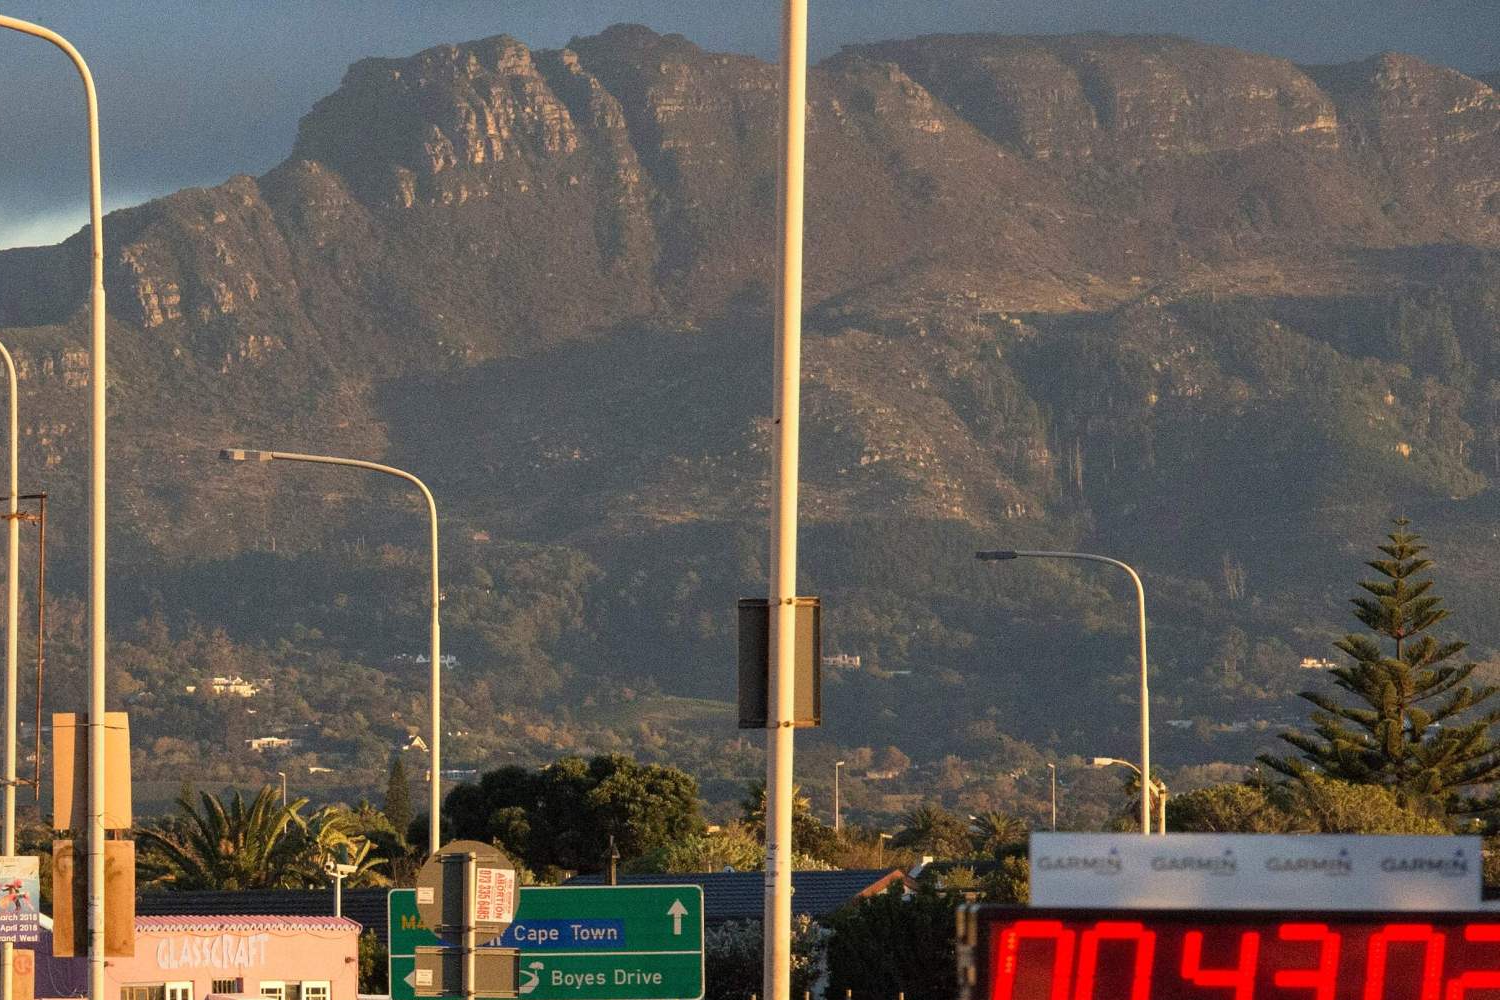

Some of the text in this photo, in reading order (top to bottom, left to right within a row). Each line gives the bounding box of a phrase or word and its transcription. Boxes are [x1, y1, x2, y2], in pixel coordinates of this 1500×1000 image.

[1037, 854, 1123, 874] GARMIN
[1151, 855, 1238, 874] GARMIN
[1266, 856, 1353, 874] GARMIN
[1381, 856, 1468, 874] GARMIN
[495, 872, 506, 920] ABORTION
[19, 913, 38, 921] 2018
[0, 923, 18, 934] April
[19, 923, 38, 932] 2018
[19, 934, 38, 942] West
[514, 924, 618, 944] Cape Town
[156, 933, 270, 969] GLASSCRAFT
[551, 968, 663, 989] Boyes Drive
